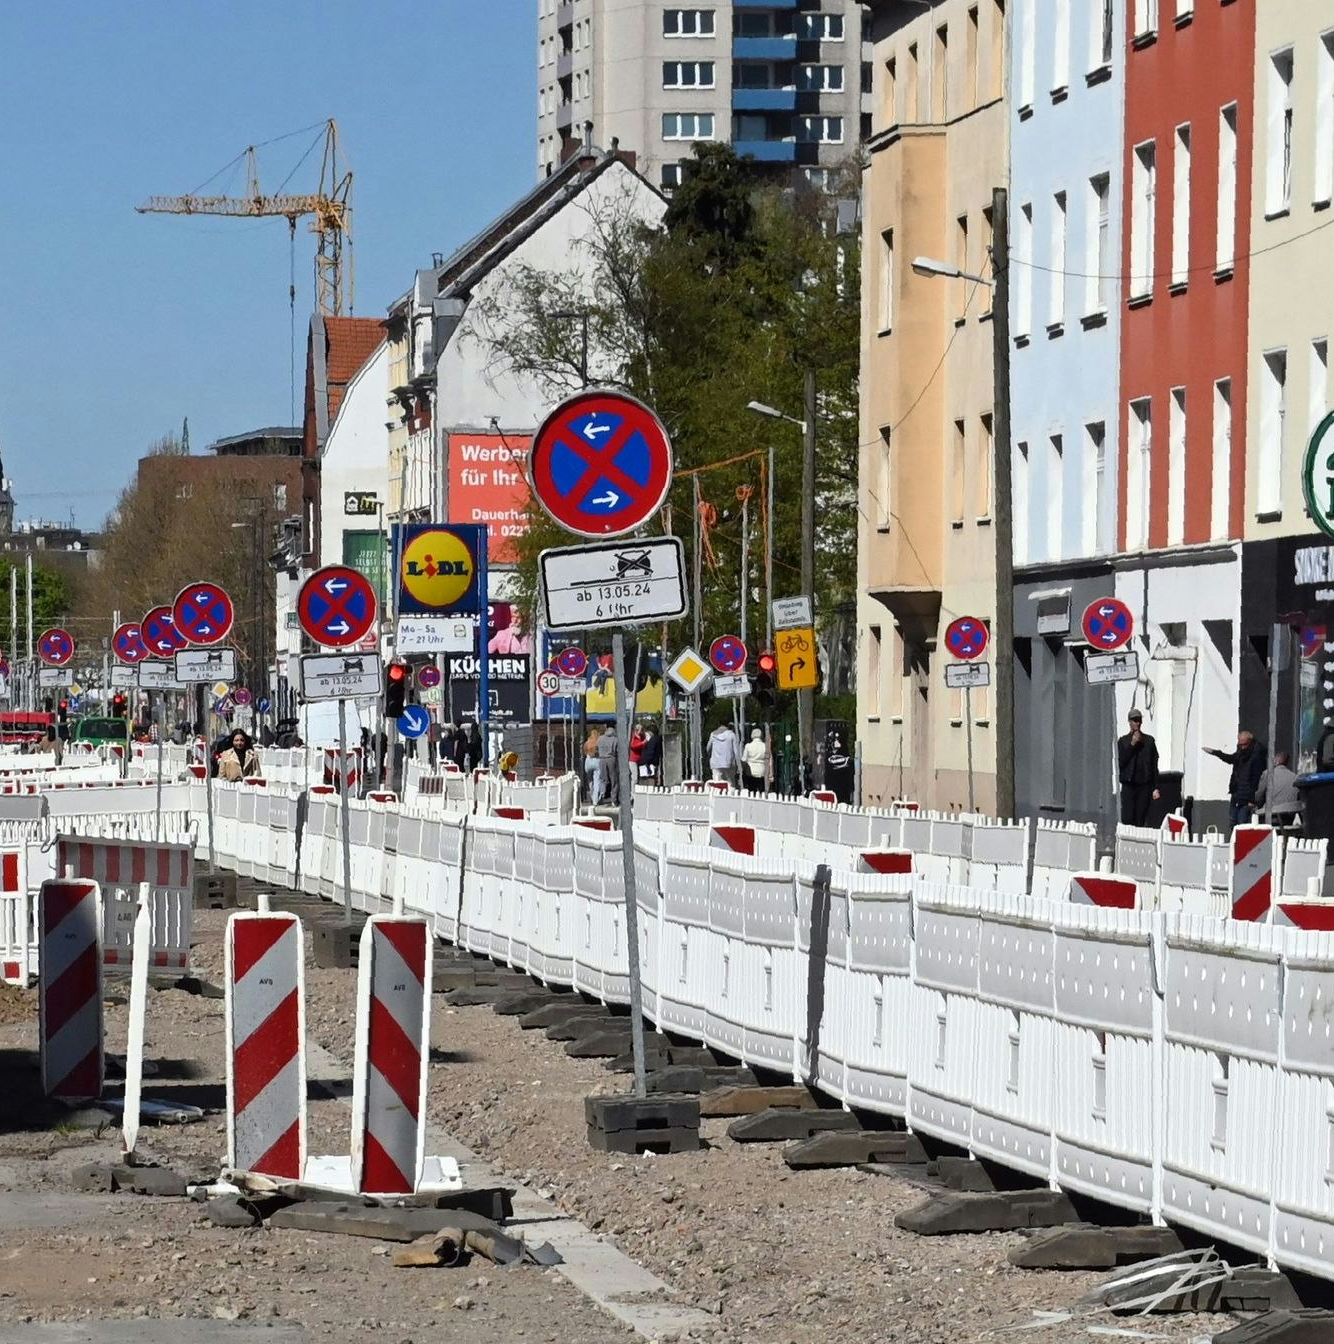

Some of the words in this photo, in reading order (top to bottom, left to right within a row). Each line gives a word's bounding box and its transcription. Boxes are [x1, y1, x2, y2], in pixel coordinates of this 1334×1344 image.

[460, 468, 488, 486] für
[493, 470, 516, 486] Ihr
[576, 589, 592, 602] ab
[598, 582, 651, 601] 13.05.24
[596, 605, 603, 617] 6
[400, 625, 415, 633] Mo
[425, 625, 436, 633] Sa
[428, 636, 445, 644] Uhr
[320, 678, 330, 686] ab
[332, 675, 363, 685] 13.05.24
[542, 676, 557, 689] 30
